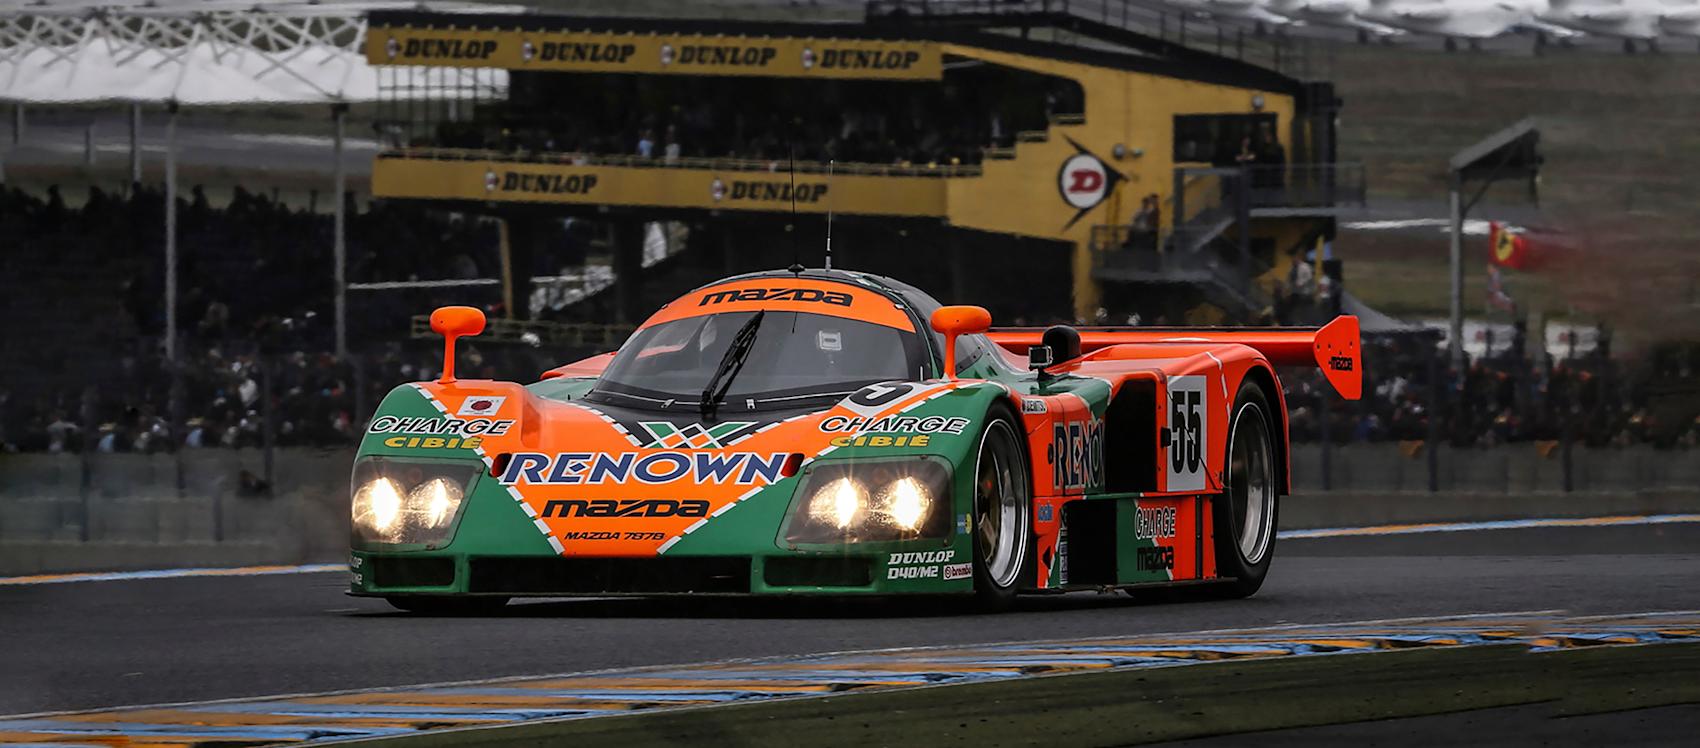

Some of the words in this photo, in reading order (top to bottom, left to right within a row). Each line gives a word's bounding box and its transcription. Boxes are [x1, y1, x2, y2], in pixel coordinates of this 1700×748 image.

[403, 38, 498, 60] DUNLOP
[539, 42, 636, 63] DUNLOP
[678, 46, 777, 66] DUNLOP
[820, 49, 919, 70] DUNLOP
[502, 172, 597, 194] DUNLOP
[730, 181, 828, 203] DUNLOP
[1068, 169, 1103, 194] D
[698, 287, 854, 307] mazda
[368, 415, 516, 436] CHARGE
[819, 415, 970, 435] CHARGE
[1172, 391, 1202, 474] 55
[830, 434, 930, 447] CIBIÉ
[499, 451, 787, 486] RENOWN
[541, 499, 711, 518] mazda
[1135, 507, 1176, 540] CHARGE
[564, 531, 621, 541] MAZDA
[624, 531, 666, 541] 787B
[888, 550, 955, 565] DUNLOP
[1136, 545, 1175, 571] mazda
[887, 565, 939, 580] D40/M2
